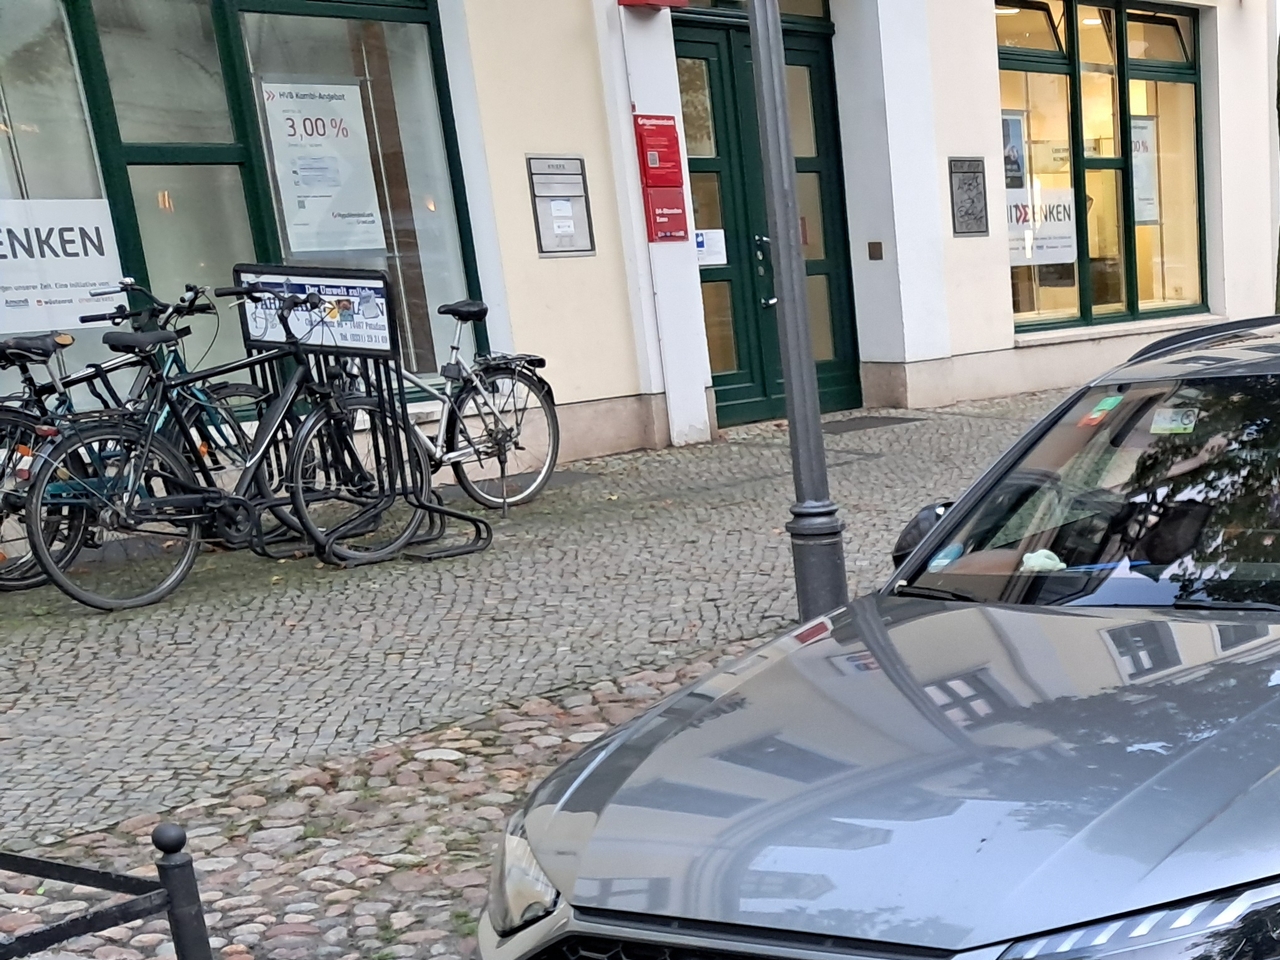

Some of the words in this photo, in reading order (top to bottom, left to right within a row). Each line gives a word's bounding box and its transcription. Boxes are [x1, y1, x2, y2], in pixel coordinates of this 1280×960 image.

[285, 117, 327, 141] 3,00
[330, 118, 349, 138] %
[320, 285, 348, 295] Umwelt
